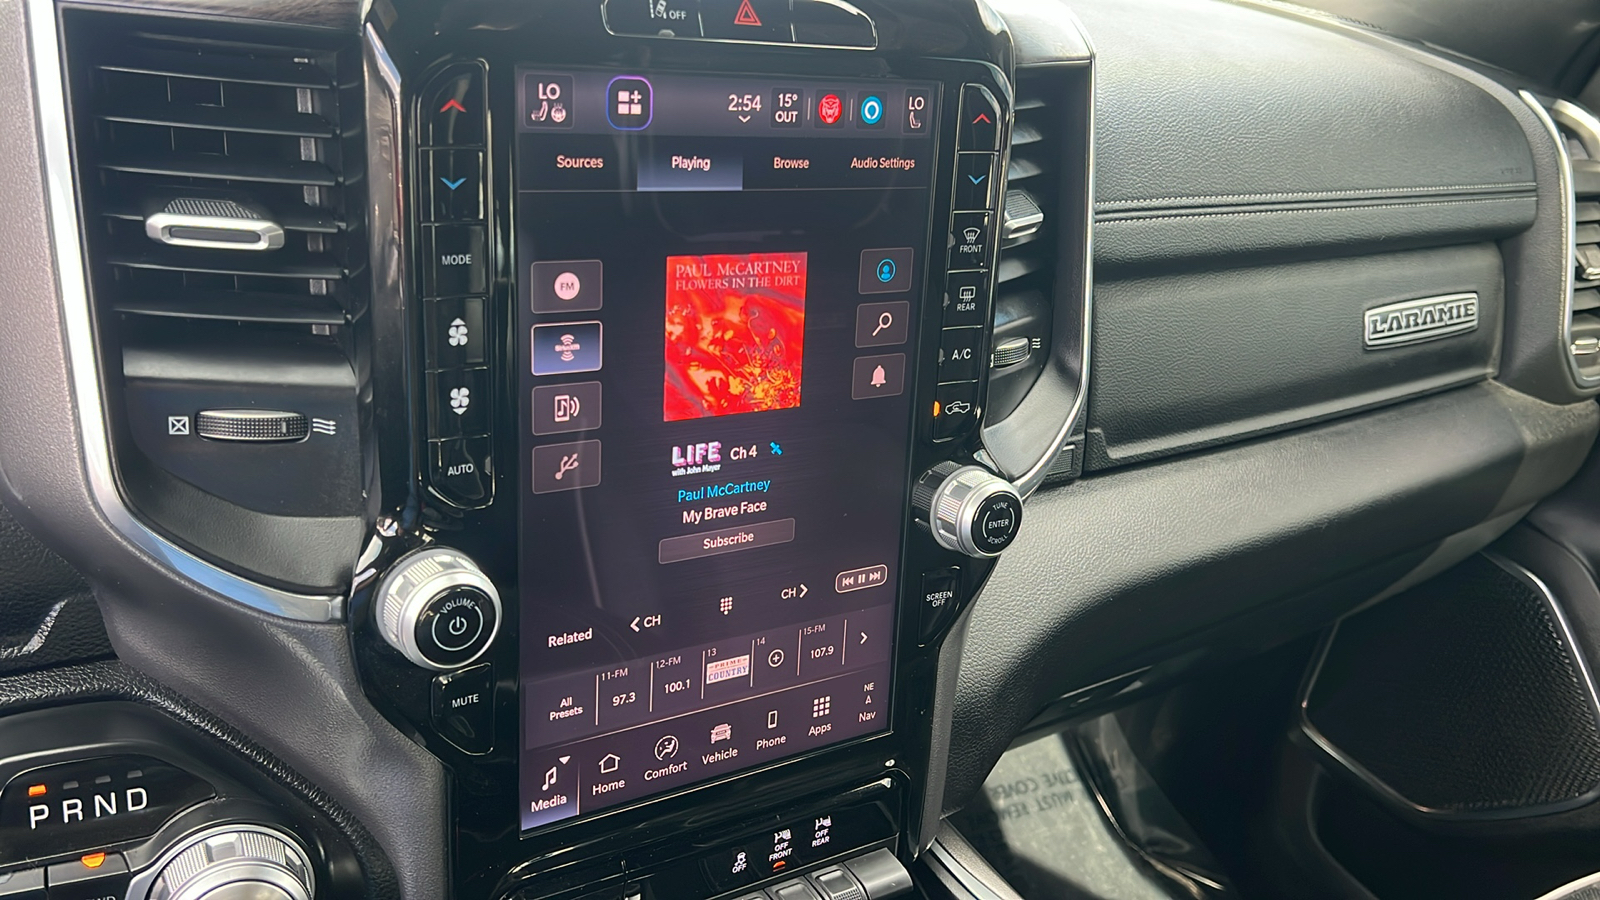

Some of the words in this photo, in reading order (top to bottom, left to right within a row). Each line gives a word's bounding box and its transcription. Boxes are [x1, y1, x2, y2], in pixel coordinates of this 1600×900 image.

[668, 9, 687, 20] OFF
[538, 83, 561, 100] LO
[728, 93, 762, 112] 2:54
[908, 95, 925, 110] LO
[775, 110, 798, 123] OUT
[556, 155, 604, 168] Sources
[671, 156, 711, 171] Playing
[773, 157, 810, 169] Browse
[850, 157, 878, 169] Audio
[879, 156, 915, 170] Settings
[959, 244, 983, 253] FRONT
[441, 254, 472, 266] MODE
[675, 263, 712, 278] PAUL
[717, 260, 801, 276] McCARTNEY
[560, 281, 575, 291] FM
[675, 278, 729, 291] FLOWERS
[731, 278, 745, 289] IN
[748, 276, 771, 288] THE
[774, 275, 801, 287] DIRT
[956, 303, 976, 311] REAR
[1370, 302, 1476, 335] LARAMIE
[951, 348, 972, 360] A/C
[672, 441, 722, 467] LIFE
[730, 446, 747, 460] Ch
[748, 444, 758, 458] 4
[447, 463, 474, 476] AUTO
[678, 487, 704, 502] Paul
[707, 480, 771, 498] McCartney
[682, 510, 702, 524] My
[704, 507, 738, 520] Brave
[740, 501, 767, 515] Face
[992, 501, 1009, 511] TUNE
[988, 518, 1010, 529] ENTER
[703, 532, 754, 549] Subscribe
[987, 534, 1009, 545] SCROLL
[781, 587, 797, 600] CH
[926, 590, 953, 602] SCREEN
[439, 597, 476, 615] VOLUME
[932, 600, 946, 608] OFF
[643, 614, 662, 628] CH
[803, 623, 826, 635] 15-FM
[548, 627, 593, 647] Related
[756, 637, 766, 646] 14
[707, 648, 717, 657] 13
[810, 645, 835, 659] 107.9
[655, 655, 682, 669] 12-FM
[714, 658, 742, 670] PRIME
[601, 667, 629, 681] 11-FM
[708, 664, 748, 682] COUNTRY
[664, 678, 691, 694] 100.1
[863, 682, 875, 692] NE
[451, 693, 480, 708] MUTE
[560, 696, 573, 708] All
[612, 691, 636, 707] 97.3
[549, 706, 584, 721] Presets
[858, 710, 877, 723] Nav
[808, 722, 832, 737] Apps
[756, 735, 787, 750] Phone
[701, 747, 739, 765] Vehicle
[644, 760, 688, 781] Comfort
[592, 779, 626, 796] Home
[530, 794, 567, 813] Media
[815, 828, 829, 838] OFF
[774, 841, 789, 852] OFF
[811, 835, 831, 847] REAR
[768, 849, 793, 862] FRONT
[731, 863, 747, 874] OFF
